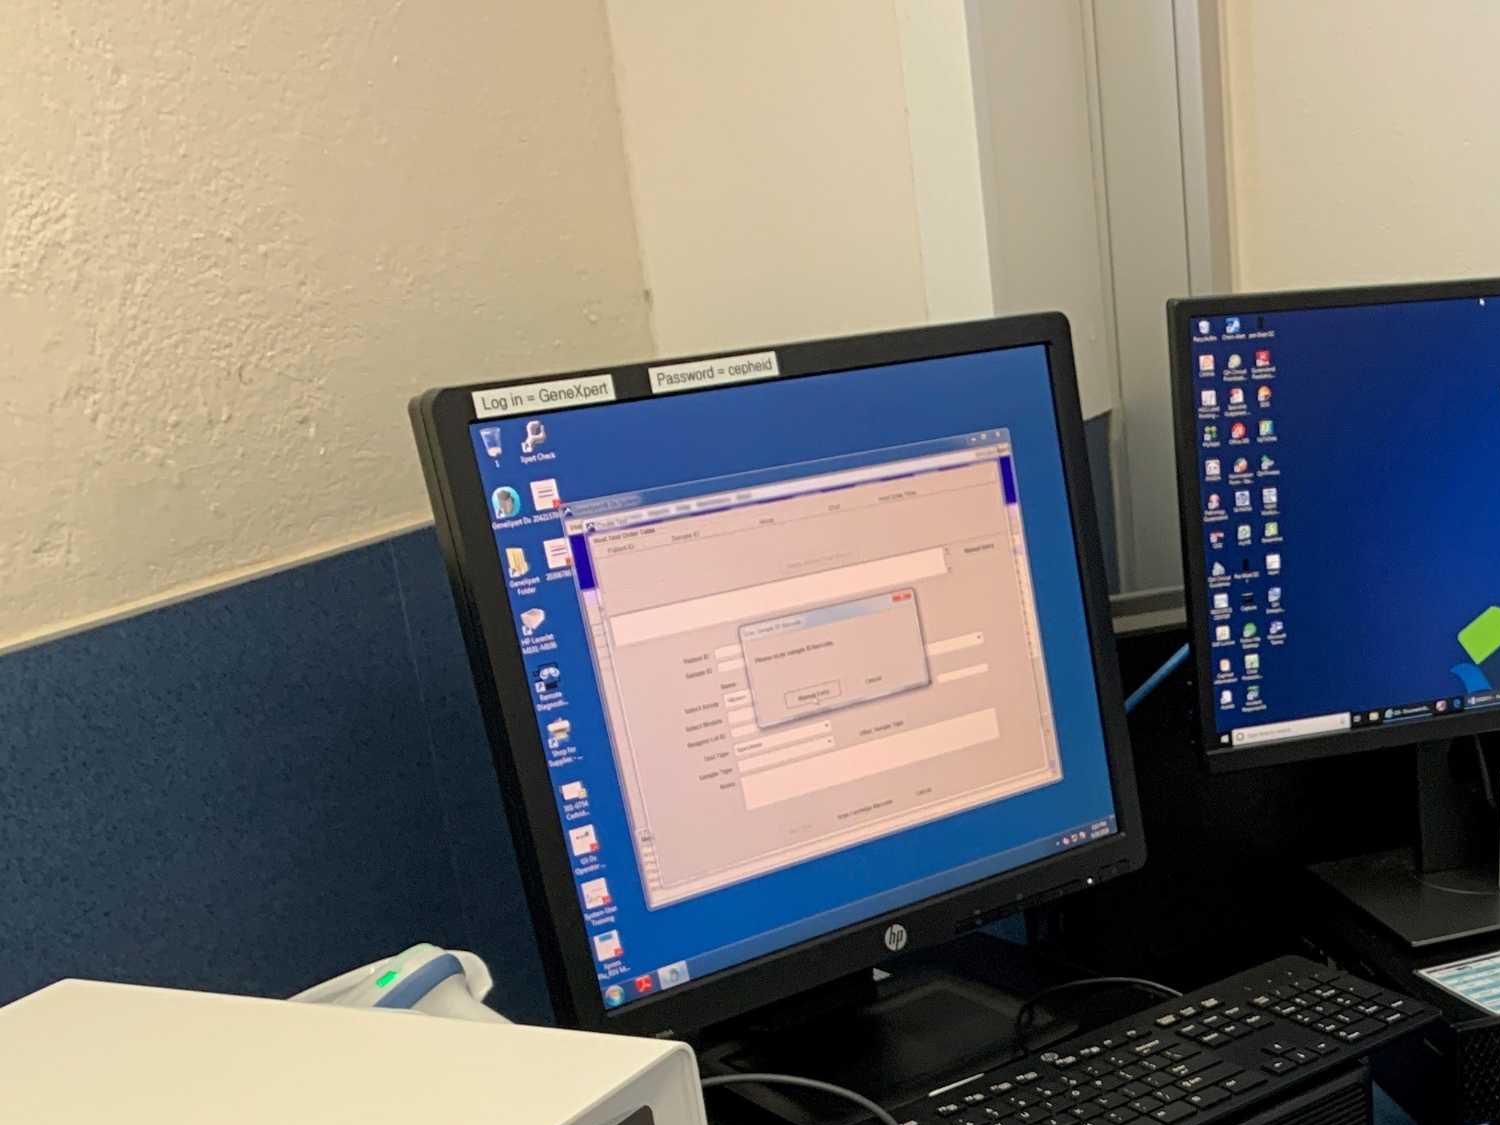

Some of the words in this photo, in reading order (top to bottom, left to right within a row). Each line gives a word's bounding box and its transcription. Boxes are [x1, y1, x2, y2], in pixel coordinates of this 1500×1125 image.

[657, 367, 714, 386] Password
[728, 359, 773, 379] cepheid
[482, 395, 507, 411] Log
[511, 391, 523, 407] in
[539, 382, 609, 404] GeneXpert
